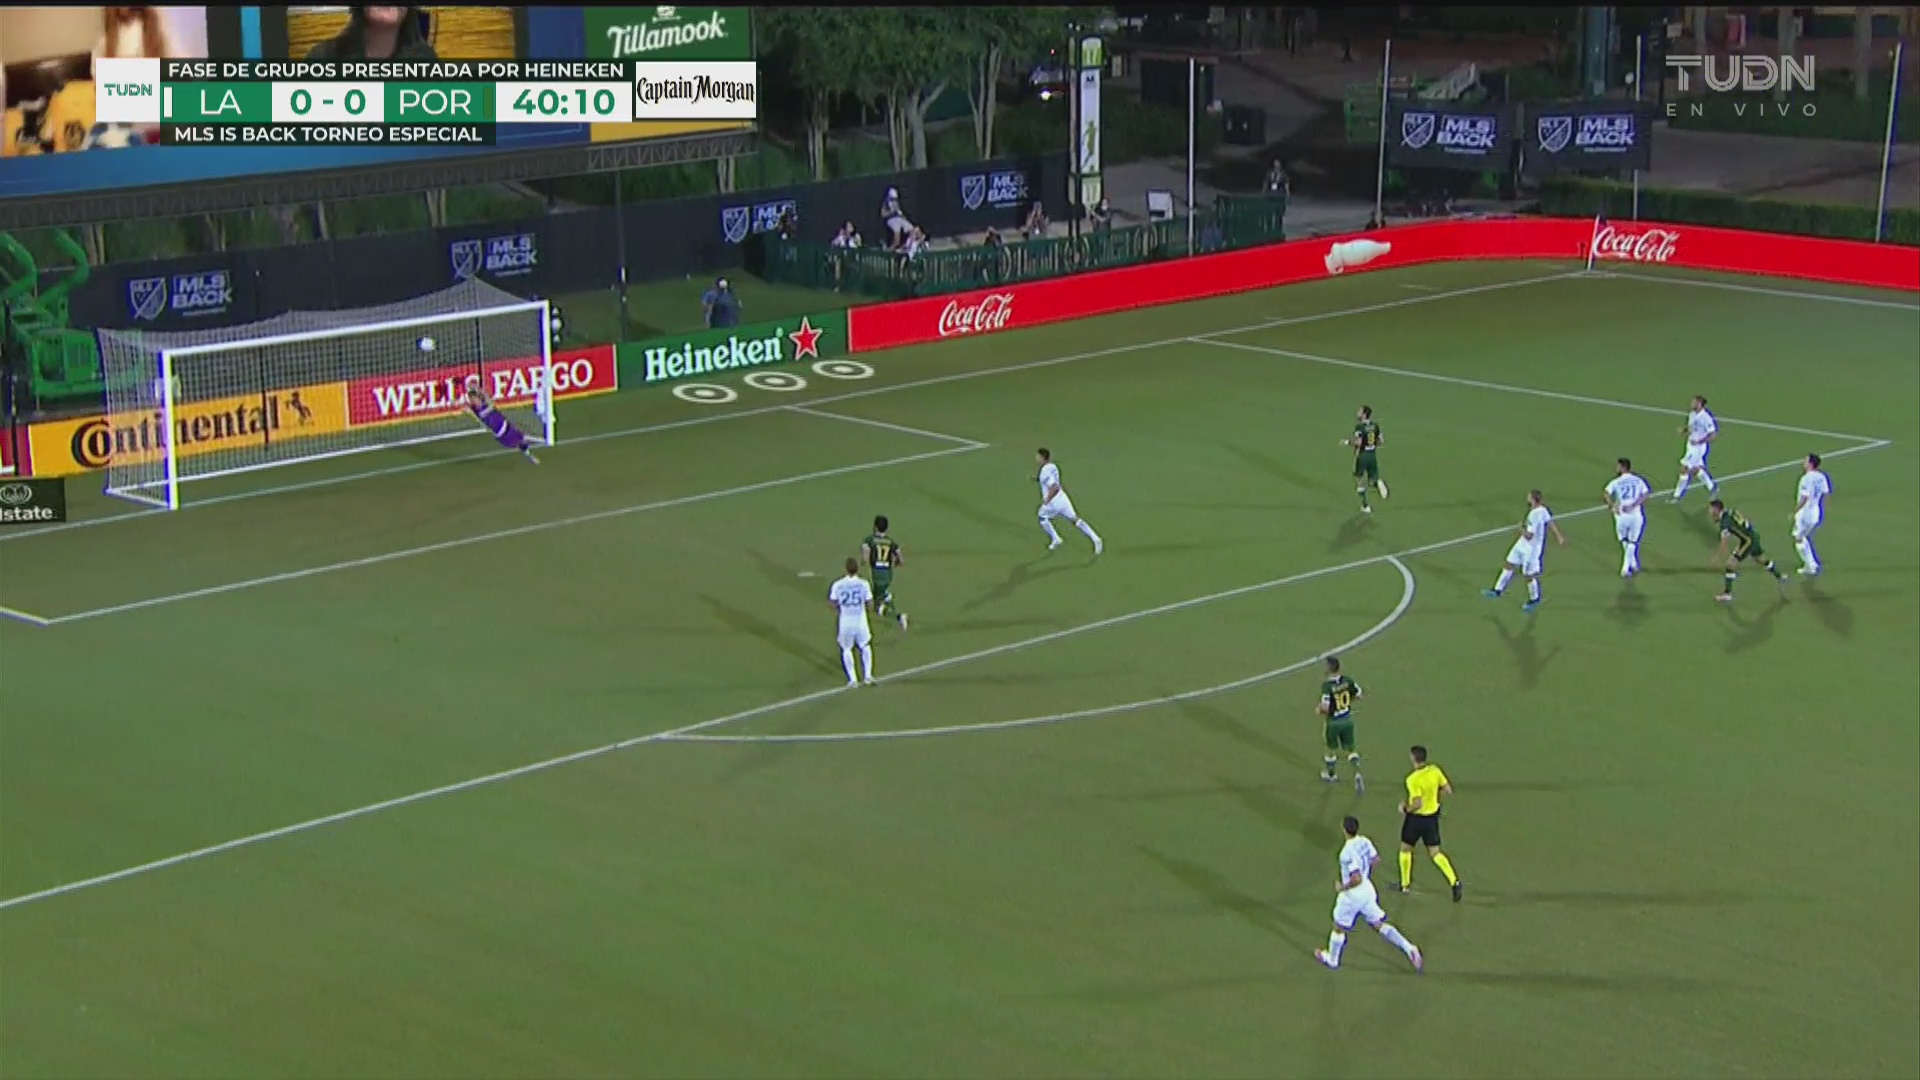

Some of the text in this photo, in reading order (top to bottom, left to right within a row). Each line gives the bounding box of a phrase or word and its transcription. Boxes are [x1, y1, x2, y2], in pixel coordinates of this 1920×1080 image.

[607, 10, 725, 58] Tillamook
[486, 249, 538, 270] BACK
[179, 275, 225, 293] MLS
[172, 288, 232, 309] BACK
[644, 336, 783, 382] Heineken
[492, 358, 593, 398] FARGO
[71, 394, 280, 468] Continental
[876, 544, 890, 562] 17
[840, 590, 862, 606] 25
[1333, 690, 1351, 711] 10
